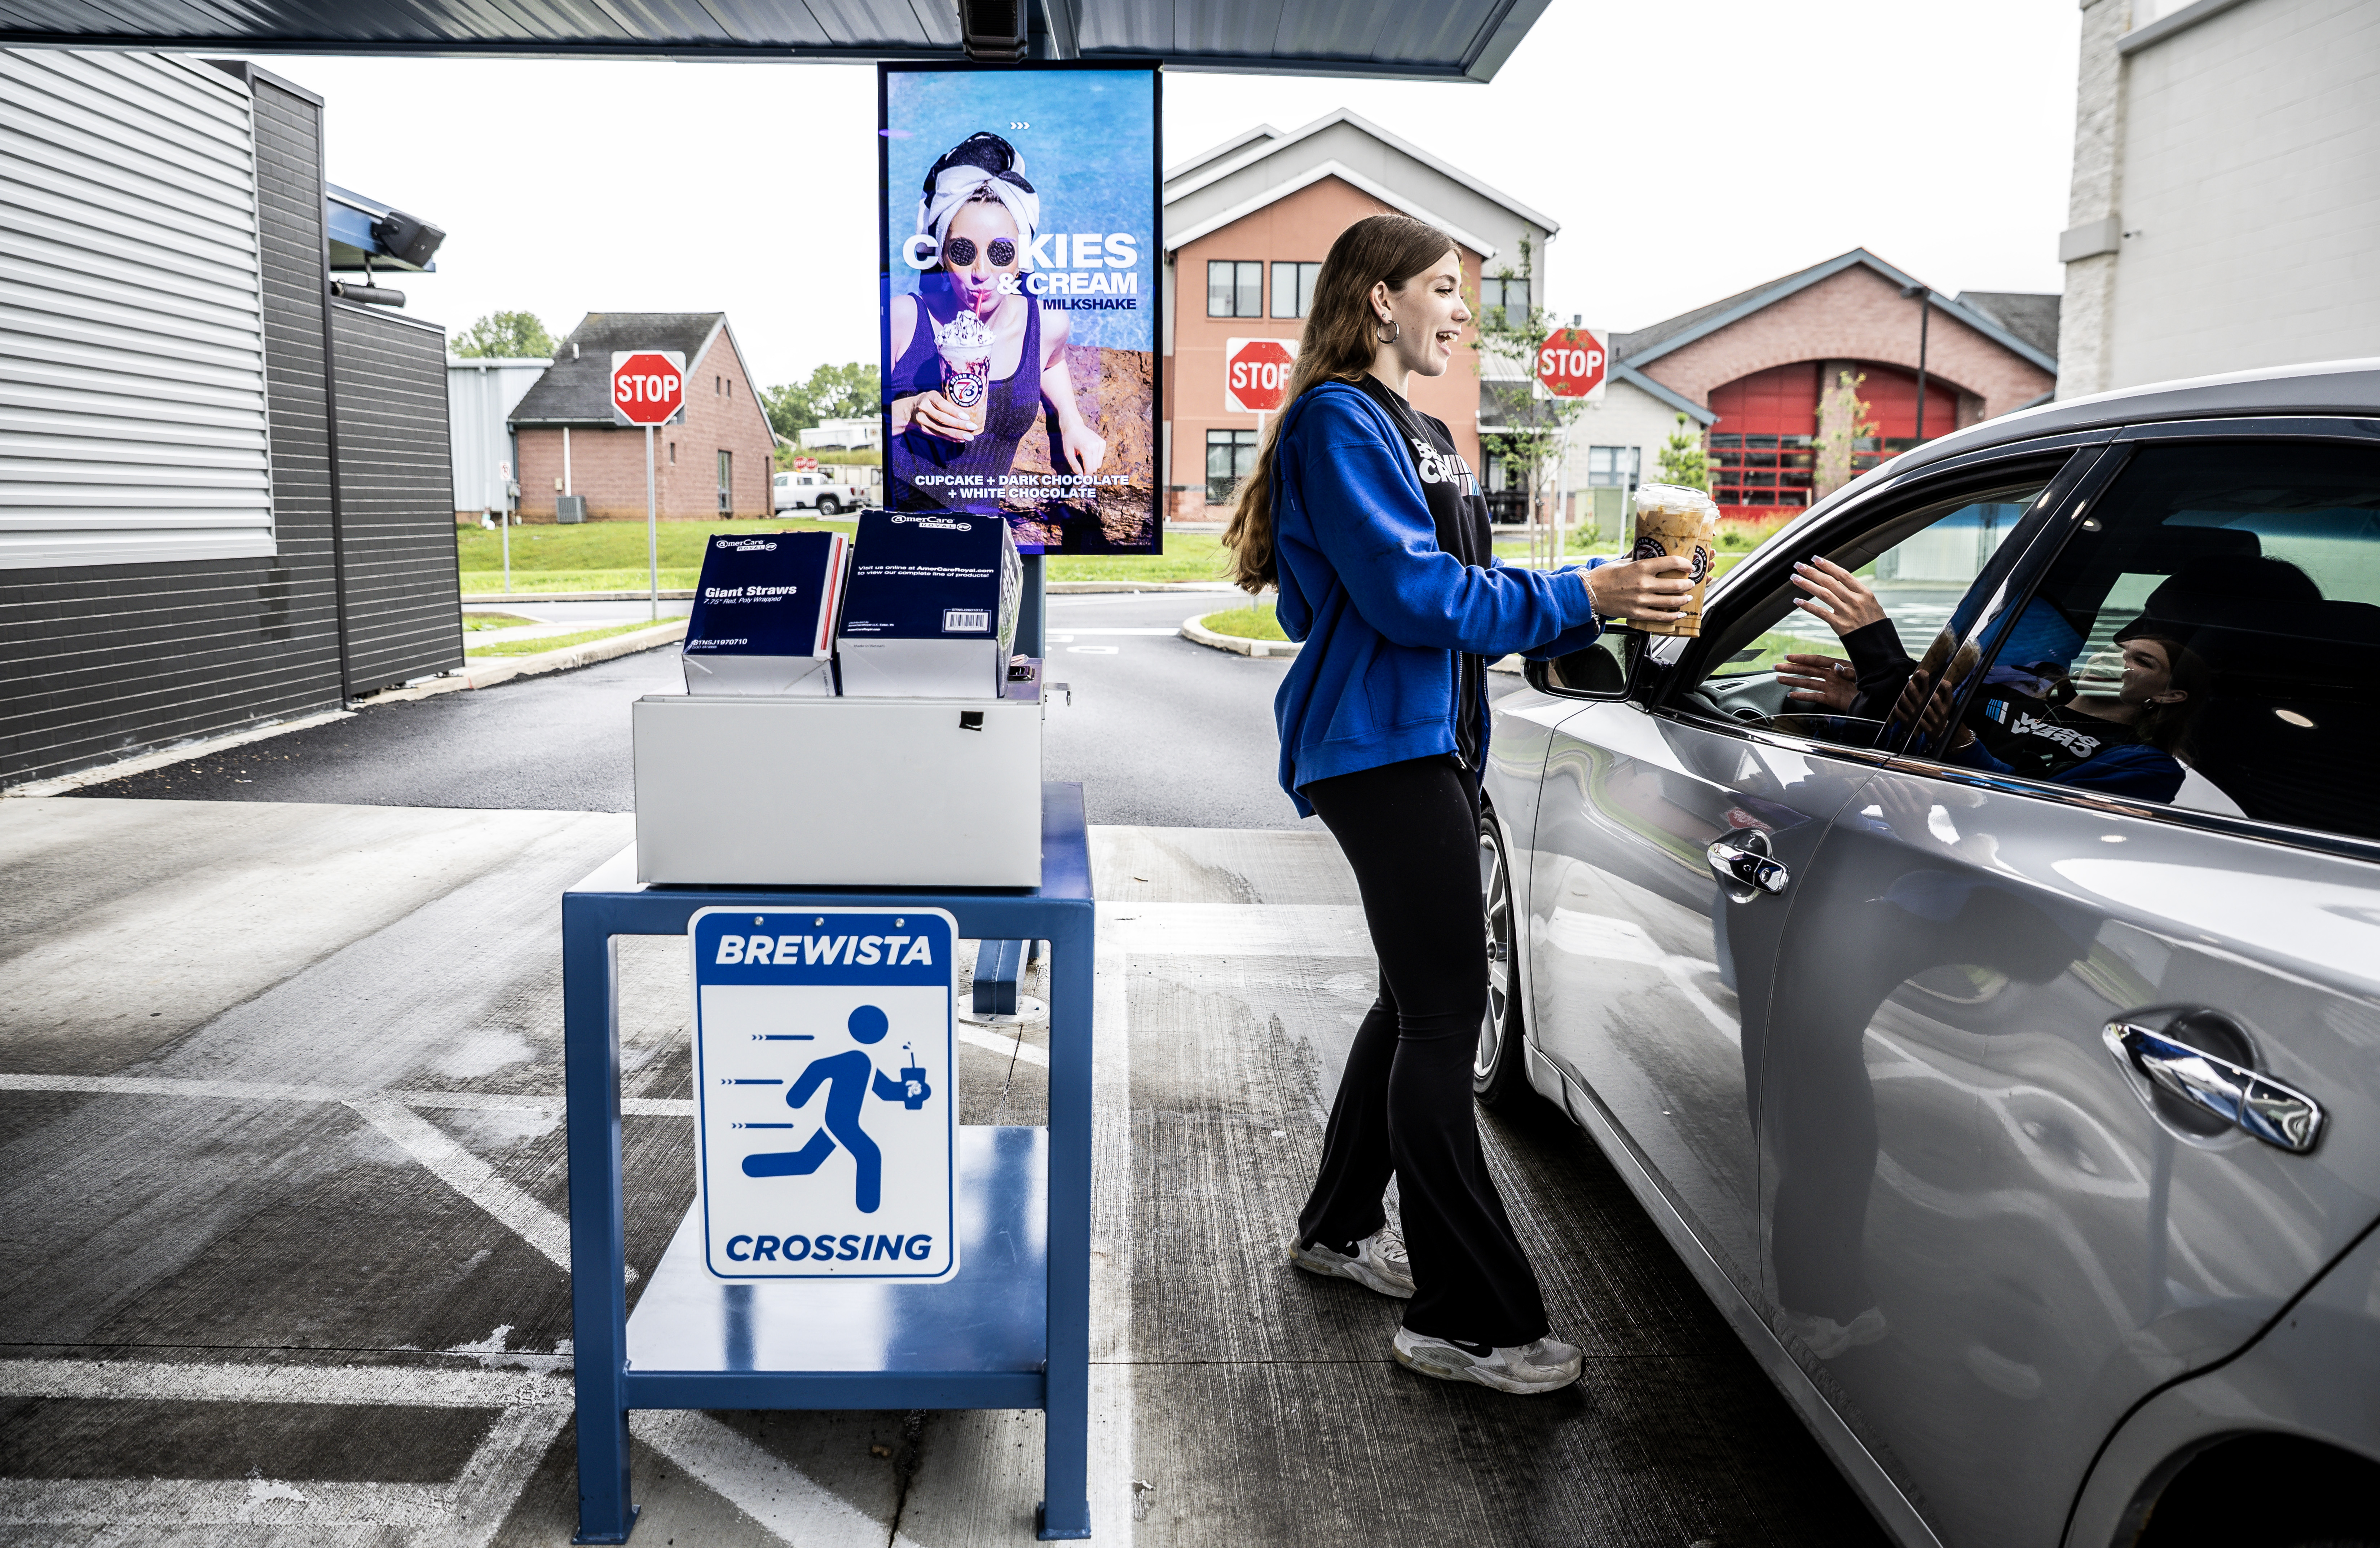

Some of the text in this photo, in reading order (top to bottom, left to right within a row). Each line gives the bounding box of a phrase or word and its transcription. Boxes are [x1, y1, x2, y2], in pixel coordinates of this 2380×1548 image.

[997, 273, 1138, 295] & CREAM
[1043, 299, 1137, 310] MILKSHAKE
[1540, 348, 1603, 378] STOP
[950, 374, 982, 386] SEVEN BREW
[617, 374, 679, 402] STOP
[915, 475, 1129, 486] CUPCAKE + DARK CHOCOLATE
[948, 488, 1096, 499] + WHITE CHOCOLATE
[1650, 541, 1665, 556] BREW
[1696, 547, 1706, 561] BREW
[705, 586, 797, 597] Giant Straws
[716, 935, 932, 965] BREWISTA
[726, 1234, 933, 1262] CROSSING
